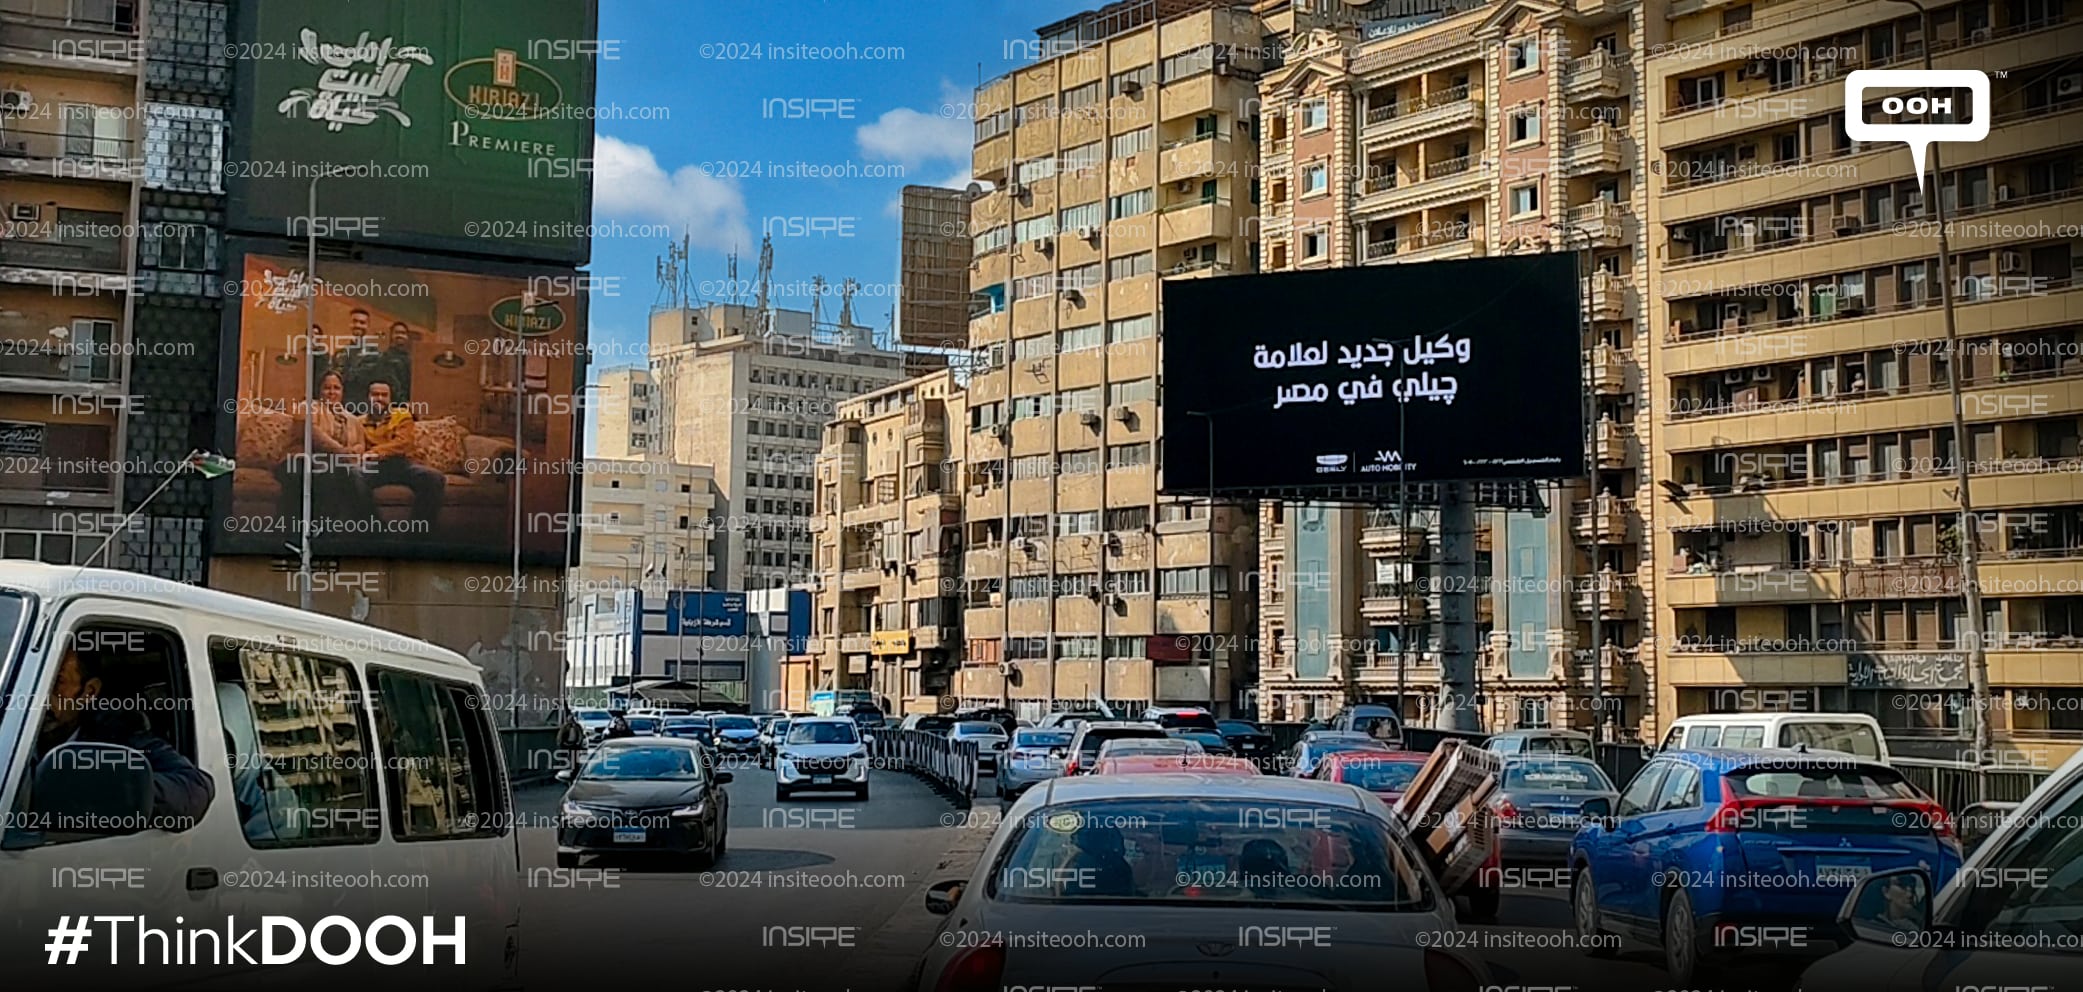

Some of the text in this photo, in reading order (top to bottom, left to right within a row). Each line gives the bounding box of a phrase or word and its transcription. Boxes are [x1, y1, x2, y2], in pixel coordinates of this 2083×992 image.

[1253, 333, 1471, 369] وكيل جديد لعلامة
[1273, 383, 1329, 409] مصر
[1337, 374, 1383, 405] في
[1361, 463, 1417, 472] AUTO MOBIITY
